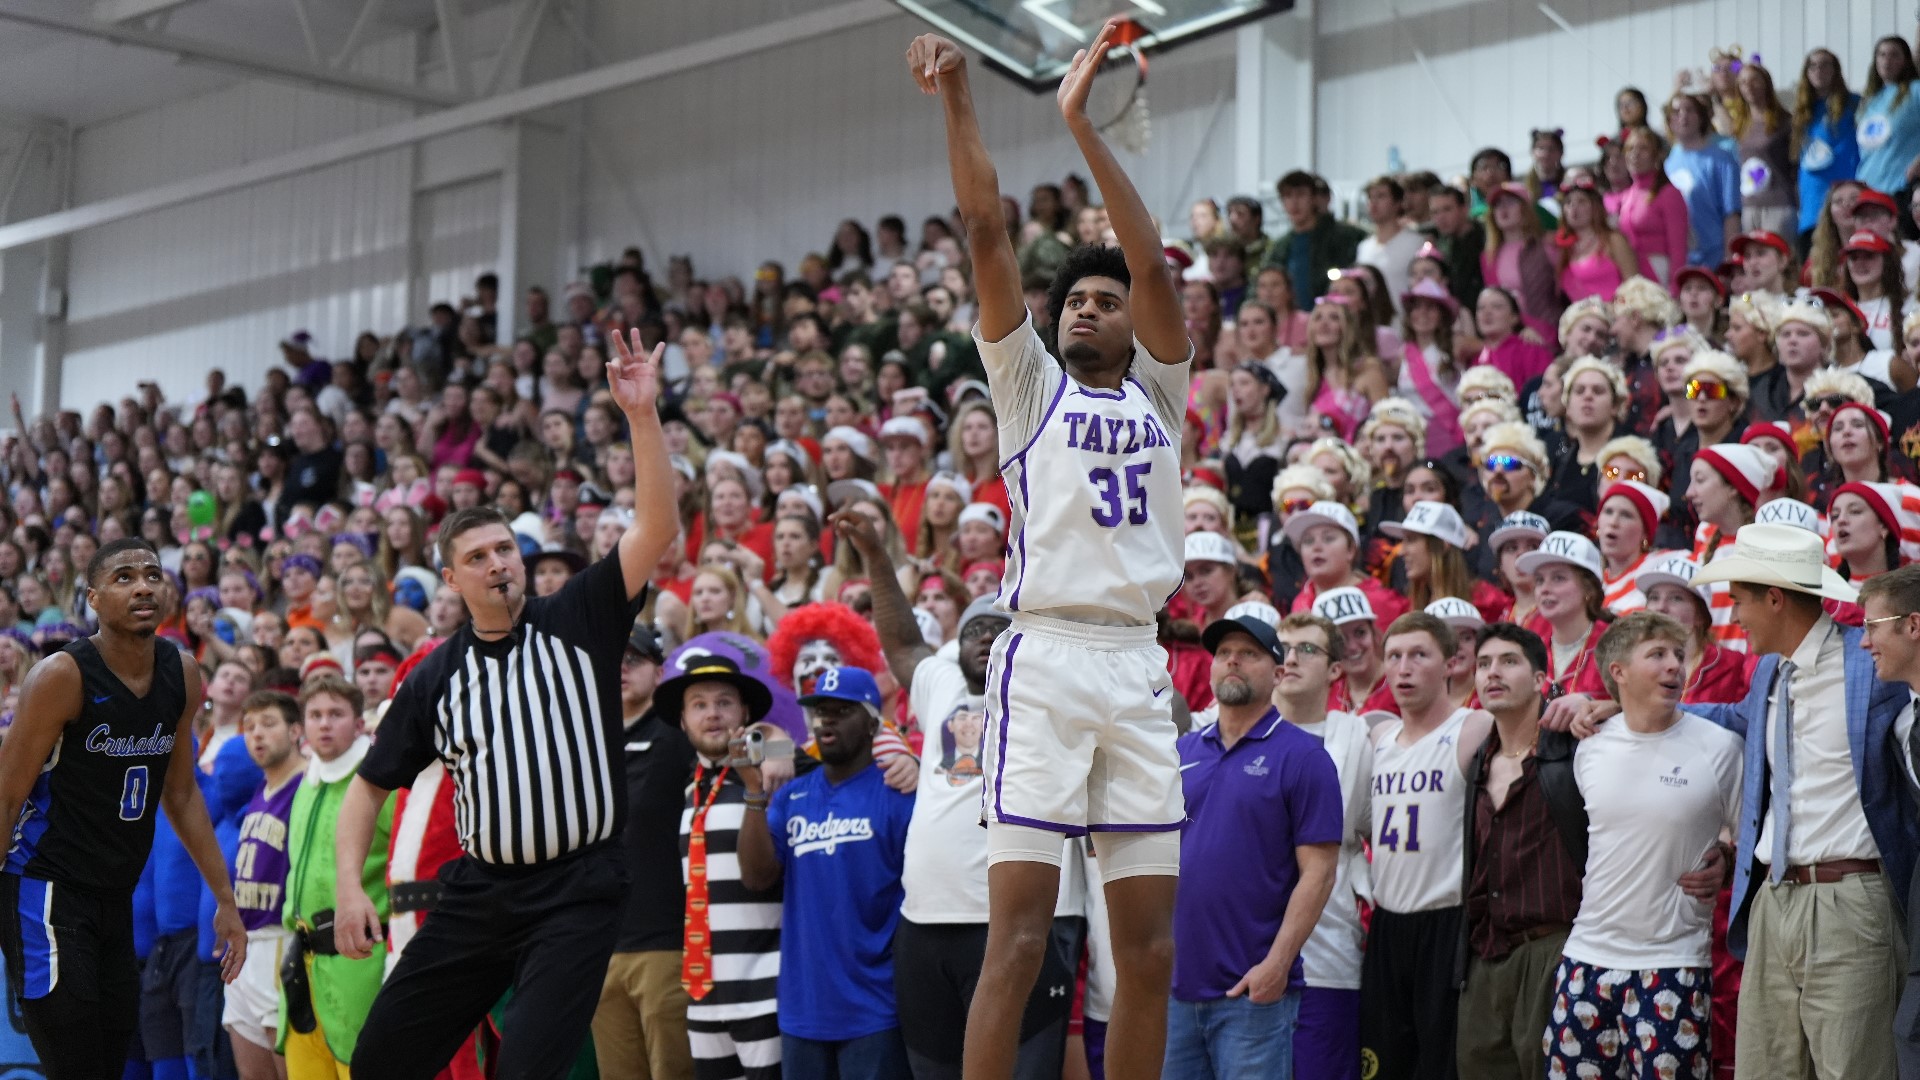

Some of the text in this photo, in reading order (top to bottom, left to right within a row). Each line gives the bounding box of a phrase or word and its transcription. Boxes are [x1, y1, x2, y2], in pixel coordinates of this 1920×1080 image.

[1062, 412, 1171, 455] TAYLOR
[1088, 461, 1152, 528] 35
[1761, 503, 1808, 523] XXIV
[1318, 593, 1366, 619] XXIV
[822, 669, 839, 692] B
[86, 723, 177, 757] Crusader
[119, 766, 148, 821] 0
[786, 811, 874, 858] Dodgers
[1378, 804, 1420, 853] 41
